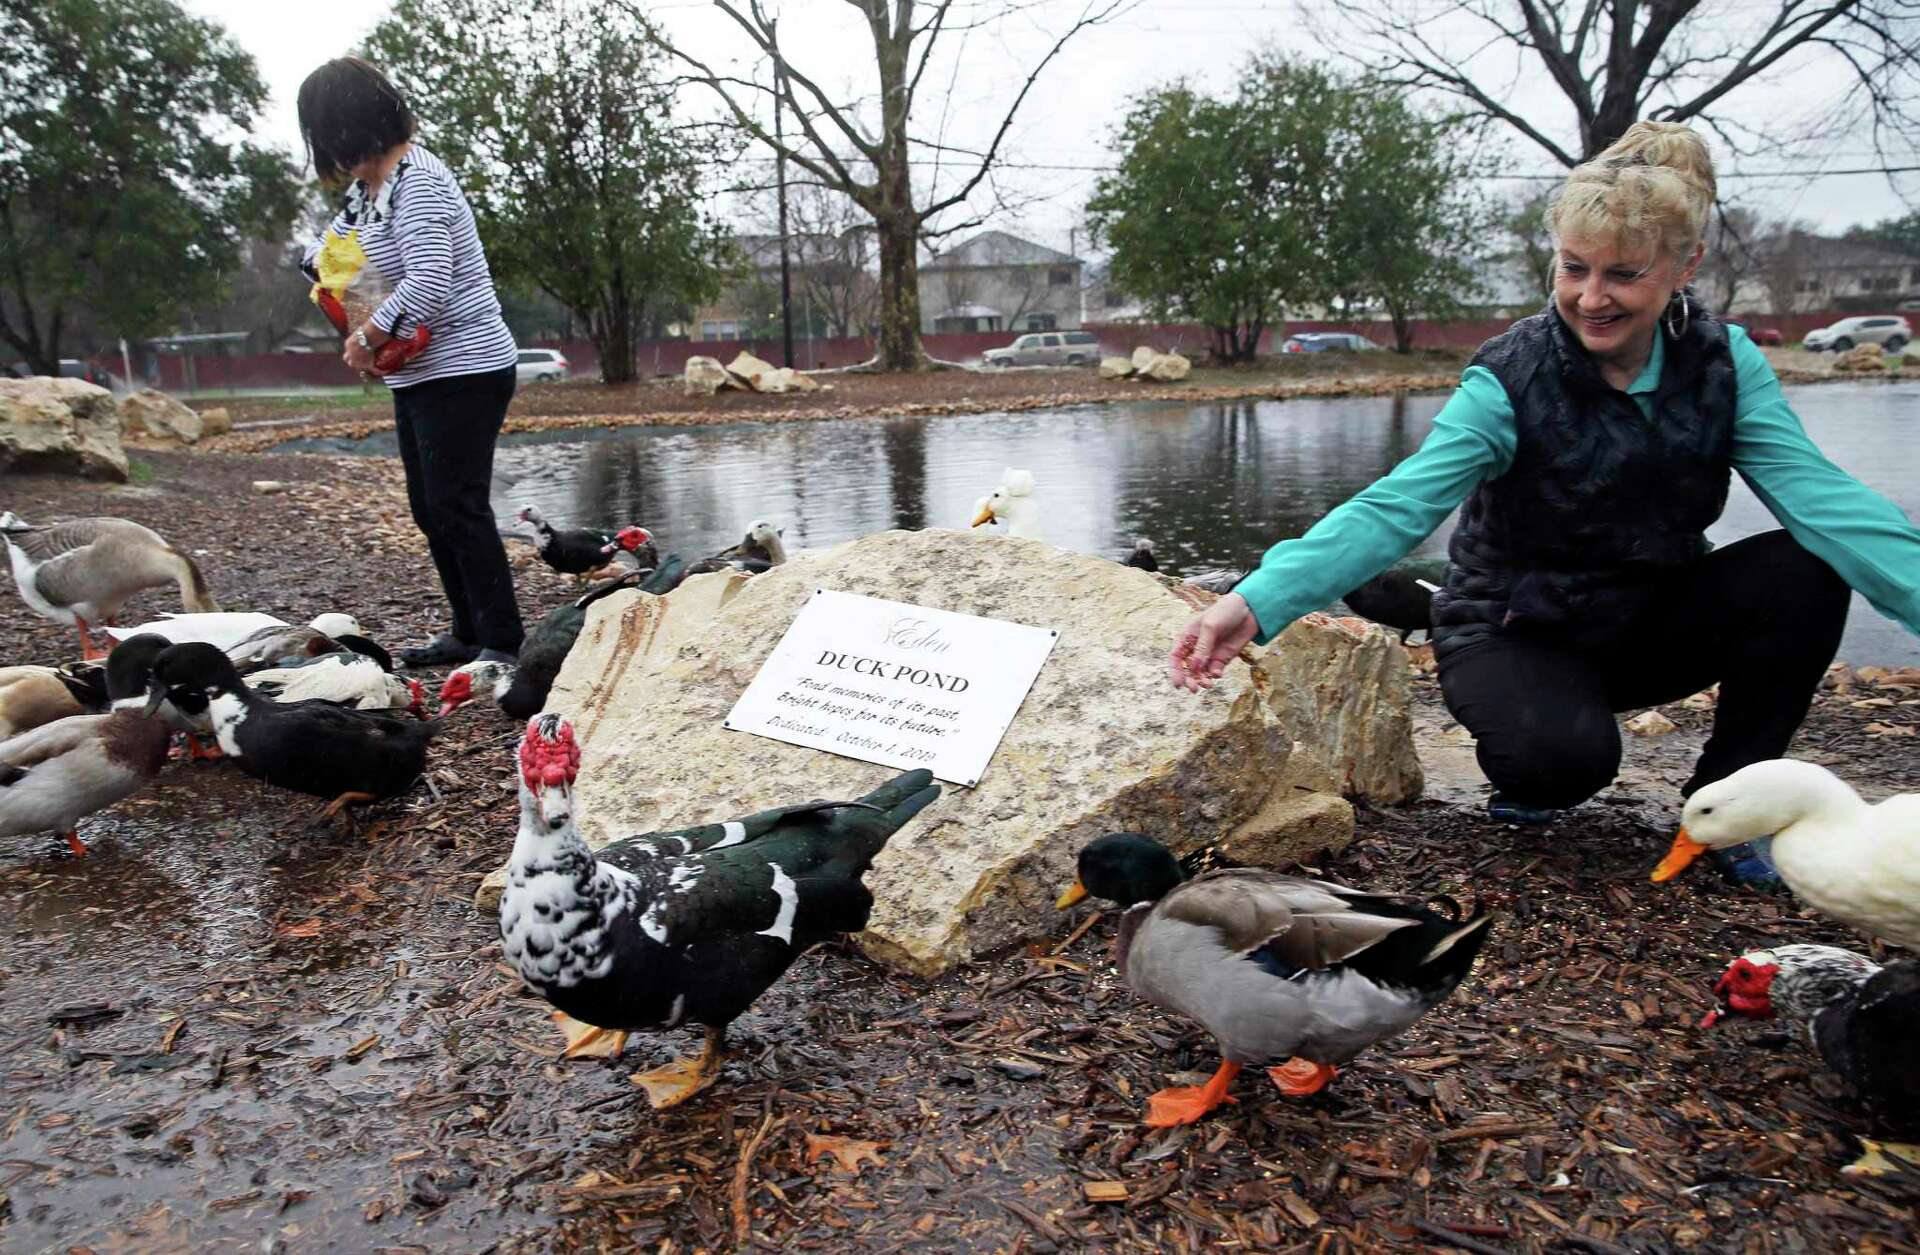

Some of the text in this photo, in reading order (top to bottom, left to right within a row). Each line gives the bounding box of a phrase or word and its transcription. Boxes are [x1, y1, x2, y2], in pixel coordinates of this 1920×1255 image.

[883, 617, 951, 653] Eden
[816, 650, 969, 693] DUCK POND
[777, 692, 820, 708] Bright
[819, 700, 854, 716] hopes
[854, 707, 877, 720] for
[880, 714, 899, 726] its
[829, 687, 887, 704] memories
[888, 697, 908, 710] of
[906, 701, 926, 712] its
[836, 732, 882, 750] October
[900, 747, 937, 761] 2019
